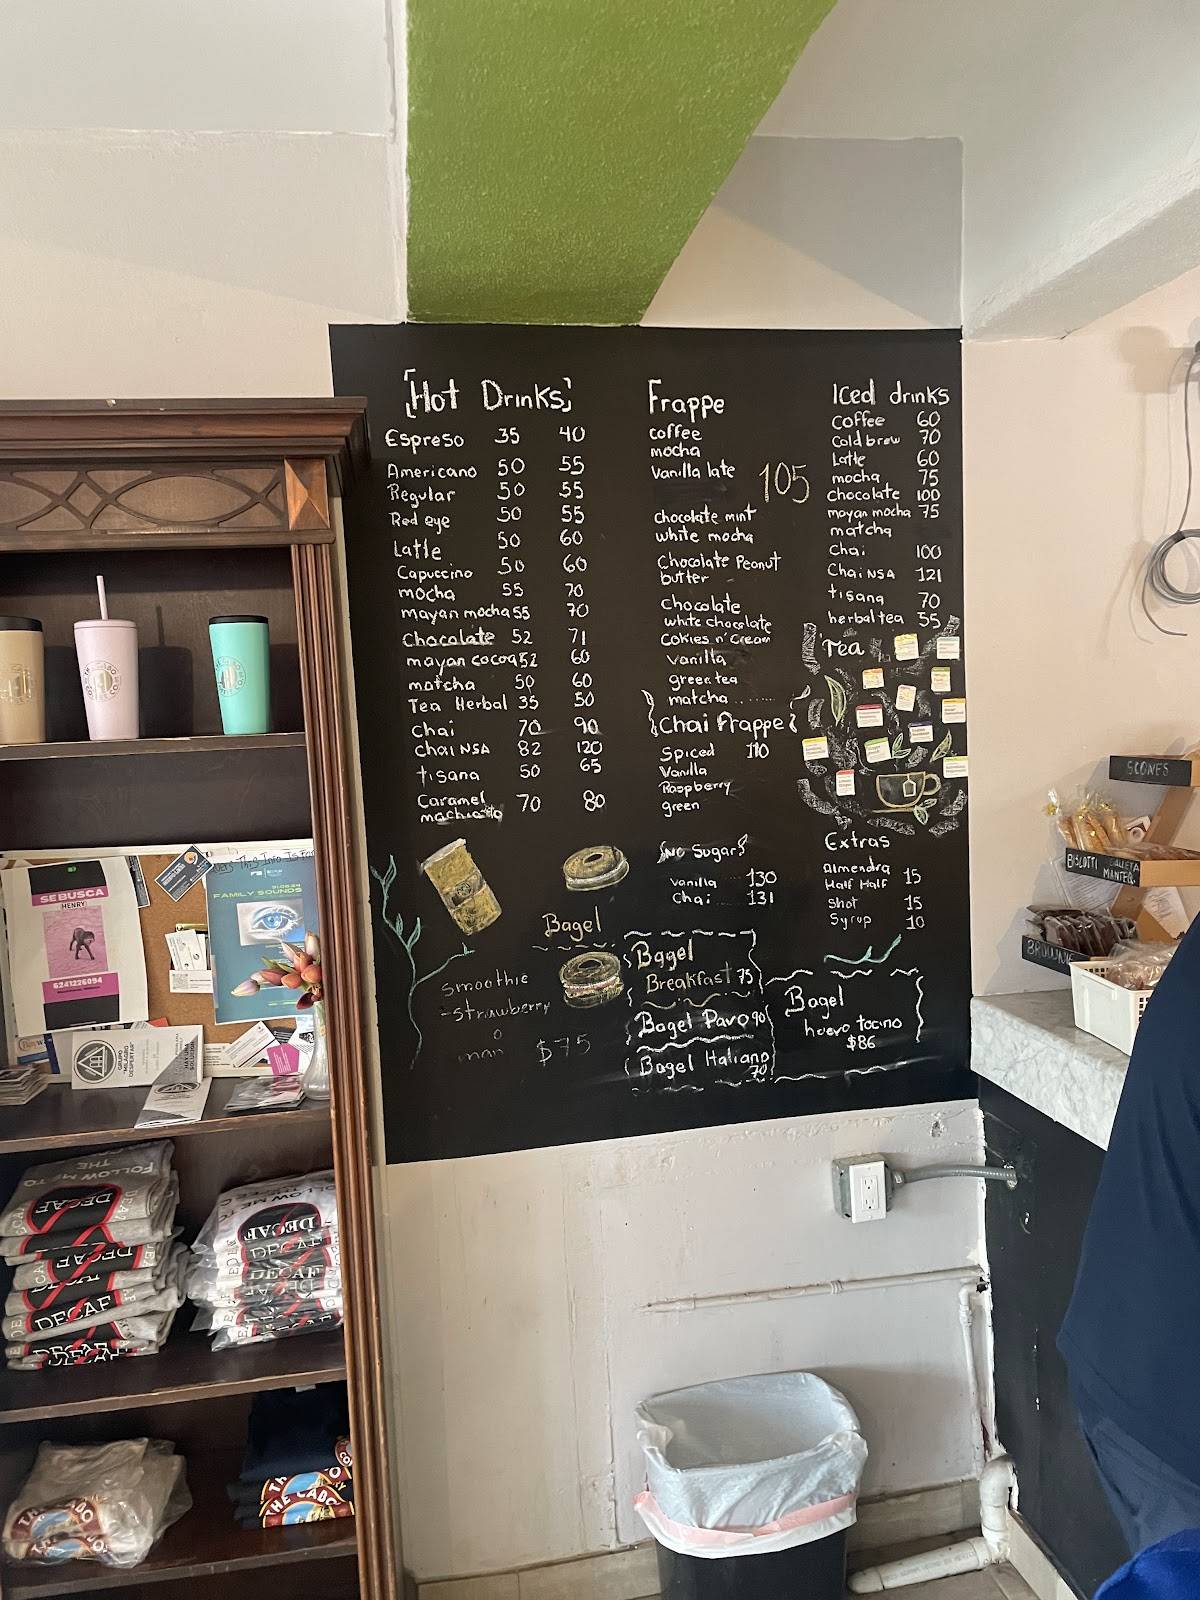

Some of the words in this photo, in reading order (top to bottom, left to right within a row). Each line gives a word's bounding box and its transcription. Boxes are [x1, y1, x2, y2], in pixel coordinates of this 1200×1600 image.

[411, 379, 459, 412] Hot
[481, 379, 566, 412] Drinks
[648, 379, 724, 422] Frappe
[834, 379, 875, 405] Iced
[890, 381, 949, 405] drinks
[917, 411, 940, 427] 60
[385, 429, 464, 454] Espreso
[495, 427, 519, 444] 35
[560, 426, 585, 442] 40
[650, 423, 702, 440] coffee
[866, 435, 900, 446] brew
[919, 429, 941, 444] 70
[651, 442, 700, 457] mocha
[833, 450, 865, 467] Latte
[917, 449, 939, 466] 60
[388, 464, 477, 479] Americano
[498, 458, 525, 476] 50
[559, 456, 584, 475] 55
[707, 459, 735, 478] late
[759, 462, 809, 503] 105
[832, 469, 880, 484] mocha
[919, 469, 938, 486] 75
[387, 483, 455, 508] Regular
[497, 482, 525, 500] 50
[559, 481, 583, 499] 55
[917, 489, 940, 501] 100
[389, 512, 418, 526] Red
[425, 516, 449, 534] eye
[497, 507, 521, 522] 50
[562, 505, 584, 524] 55
[725, 504, 756, 521] mint
[828, 510, 868, 525] mayan
[873, 503, 911, 517] mocha
[919, 504, 939, 518] 75
[656, 525, 699, 543] white
[708, 527, 753, 543] mocha
[831, 521, 891, 537] matcha
[395, 538, 441, 560] Latte
[498, 532, 520, 549] 50
[560, 529, 583, 546] 60
[917, 545, 941, 559] 100
[398, 563, 473, 583] Capuccino
[498, 557, 524, 574] 50
[563, 554, 587, 573] 60
[658, 551, 729, 569] Chocolate
[660, 570, 709, 585] butter
[867, 569, 895, 579] NSA
[915, 568, 941, 582] 121
[399, 585, 455, 602] mocha
[503, 583, 523, 596] 55
[565, 583, 583, 597] 70
[828, 584, 884, 605] tisana
[918, 592, 940, 609] 70
[401, 609, 458, 625] mayan
[464, 604, 510, 618] mocha
[513, 606, 530, 620] 55
[567, 603, 588, 617] 70
[664, 612, 701, 626] white
[828, 609, 875, 624] herbal
[878, 611, 904, 624] tea
[917, 612, 941, 629] 55
[512, 629, 532, 644] 52
[568, 628, 585, 645] 71
[822, 639, 864, 657] Tea
[407, 657, 465, 676] mayan
[472, 654, 517, 666] cocoa
[519, 652, 537, 668] 52
[571, 649, 590, 664] 60
[409, 675, 475, 691] matcha
[515, 674, 534, 692] 50
[572, 672, 592, 687] 60
[669, 675, 711, 693] green
[715, 671, 737, 684] tea
[408, 699, 441, 713] Tea
[456, 694, 507, 711] Herbal
[519, 695, 538, 710] 35
[575, 691, 594, 707] 50
[669, 689, 728, 705] matcha
[519, 720, 543, 736] 70
[574, 717, 600, 734] 90
[660, 713, 708, 734] Chai
[460, 743, 490, 755] NSA
[518, 740, 541, 756] 82
[577, 741, 602, 755] 120
[660, 743, 714, 765] Spiced
[746, 742, 769, 758] 110
[417, 766, 479, 784] tisana
[520, 764, 540, 778] 50
[580, 758, 601, 773] 65
[1128, 761, 1169, 777] SCONES
[418, 791, 485, 808] Caramel
[516, 794, 541, 812] 70
[583, 790, 605, 811] 80
[662, 801, 699, 817] green
[825, 831, 889, 850] Extras
[692, 844, 736, 862] Sugar
[746, 868, 777, 887] 130
[823, 856, 890, 875] Almendra
[903, 868, 921, 884] 15
[825, 879, 853, 890] Half
[860, 879, 887, 889] Half
[40, 895, 56, 903] SE
[58, 889, 104, 901] BUSCA
[214, 891, 254, 899] FAMILY
[747, 890, 773, 905] 131
[904, 895, 922, 910] 15
[542, 906, 601, 941] Bagel
[906, 915, 924, 929] 10
[631, 939, 693, 971] Bagel
[644, 960, 730, 995] Breakfast
[785, 985, 843, 1019] Bagel
[634, 1011, 692, 1039] Bagel
[702, 1009, 749, 1029] Pavo
[847, 1035, 875, 1051] $86
[640, 1054, 694, 1079] Bagel
[750, 1064, 767, 1078] 70
[35, 1192, 113, 1214] DECAF
[244, 1217, 316, 1241] DECAF
[56, 1246, 133, 1268] DECAF
[35, 1296, 112, 1331] DECAF
